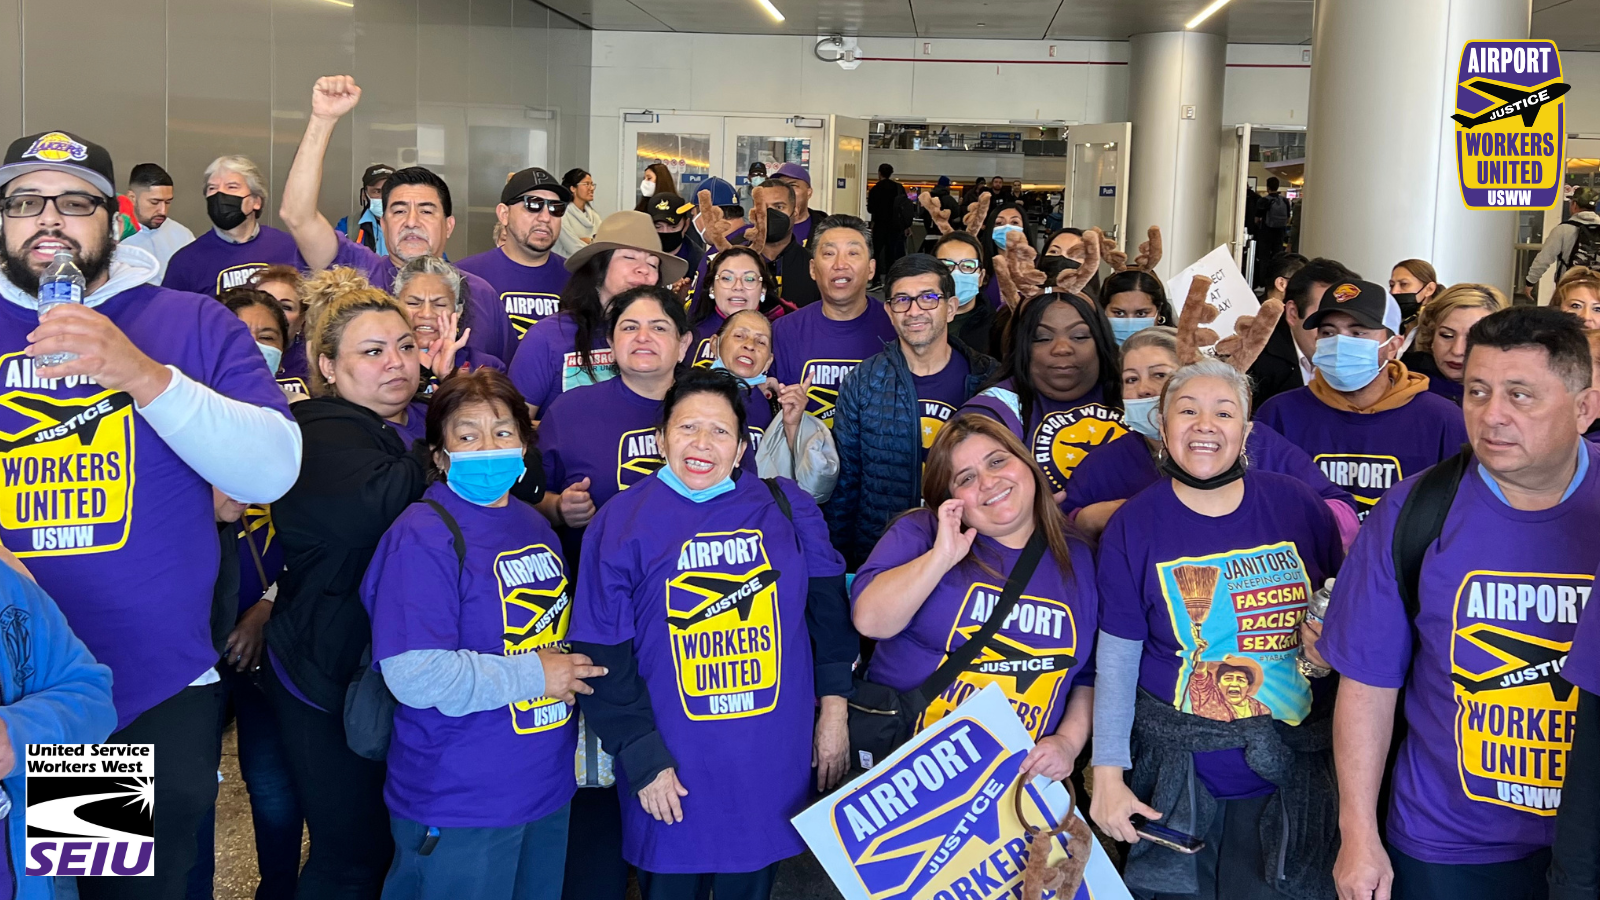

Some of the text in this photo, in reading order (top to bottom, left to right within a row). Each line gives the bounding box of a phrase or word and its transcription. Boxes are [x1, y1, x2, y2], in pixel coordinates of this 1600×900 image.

[1211, 268, 1225, 284] ECT
[505, 296, 560, 316] AIRPORT
[1210, 288, 1221, 302] AT
[1218, 298, 1232, 314] AX!
[809, 364, 855, 385] AIRPO
[34, 399, 113, 443] JUSTICE
[1035, 413, 1077, 463] AIRPORT
[2, 451, 121, 487] WORKERS
[16, 487, 107, 523] UNITED
[32, 525, 94, 550] USWW
[677, 535, 760, 571] AIRPORT
[499, 551, 560, 588] AIRPORT
[1223, 550, 1299, 580] JANITORS
[1227, 571, 1303, 591] SWEEPING OUT
[534, 592, 569, 634] JUSTICE
[705, 577, 763, 618] JUSTICE
[1235, 586, 1306, 610] FASCISM
[1467, 581, 1592, 624] AIRPORT
[970, 590, 1066, 639] AIPORT
[1241, 609, 1307, 631] RACISM
[682, 625, 771, 660] WORKERS
[1242, 631, 1298, 650] SEXISM
[695, 658, 762, 691] UNITED
[979, 657, 1055, 674] JUSTICE
[534, 701, 567, 727] USWW
[709, 691, 755, 715] USWW
[1481, 739, 1571, 782] UNITE
[842, 724, 982, 842] AIRPORT
[1497, 781, 1562, 809] USWW
[928, 778, 1005, 875] JUSTICE
